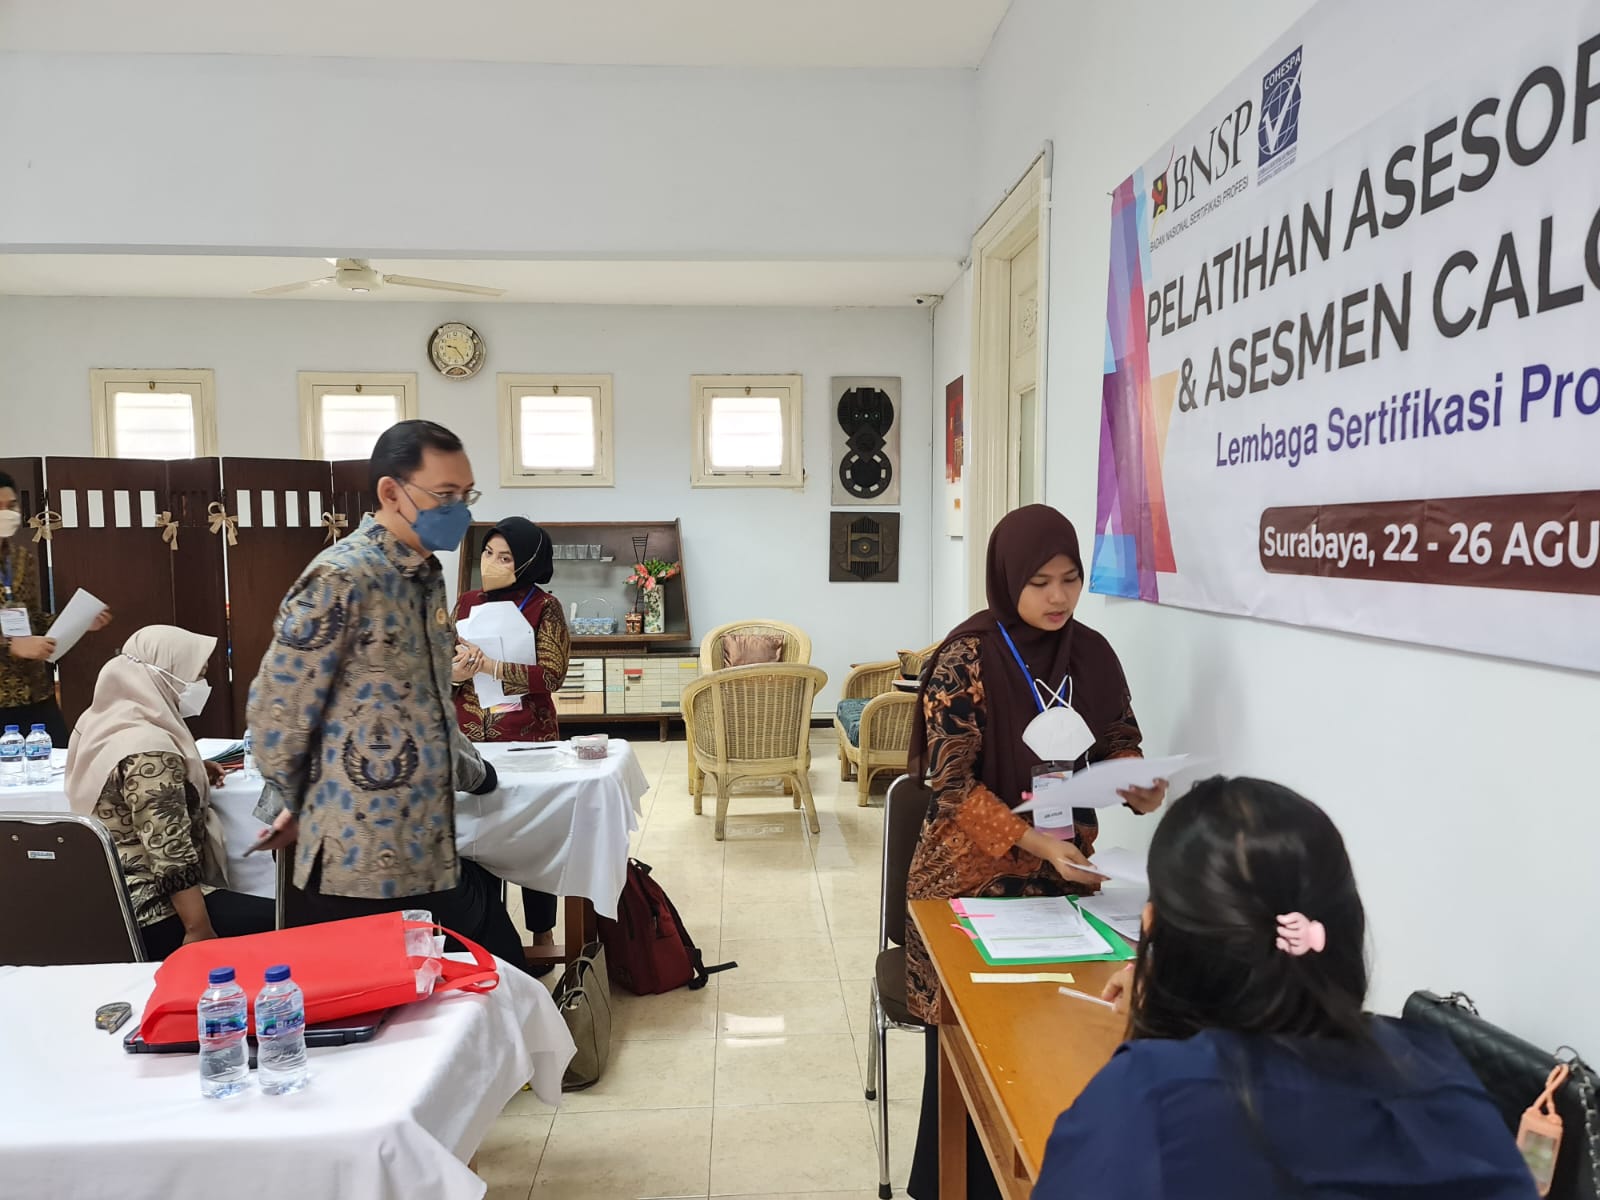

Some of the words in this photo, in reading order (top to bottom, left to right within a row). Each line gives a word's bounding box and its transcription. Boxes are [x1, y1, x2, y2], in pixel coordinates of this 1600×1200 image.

[1264, 52, 1301, 90] COHESPA
[1172, 100, 1253, 212] BNSP
[1146, 188, 1333, 343] PELATIHAN
[1150, 235, 1166, 252] BADAN
[1166, 219, 1189, 241] NASIONAL
[1189, 194, 1222, 226] SERTIFIKASI
[1223, 176, 1249, 203] PROFESI
[1178, 357, 1198, 412] &
[1204, 271, 1412, 402] ASESMEN
[1432, 205, 1600, 338] CAL
[1216, 422, 1318, 468] Lembaga
[1327, 373, 1503, 451] Sertifikasi
[1520, 363, 1600, 423] Pro
[1264, 526, 1376, 568] Surabaya,
[1383, 523, 1419, 562] 22
[1448, 522, 1493, 564] 26
[1501, 520, 1600, 569] AGU
